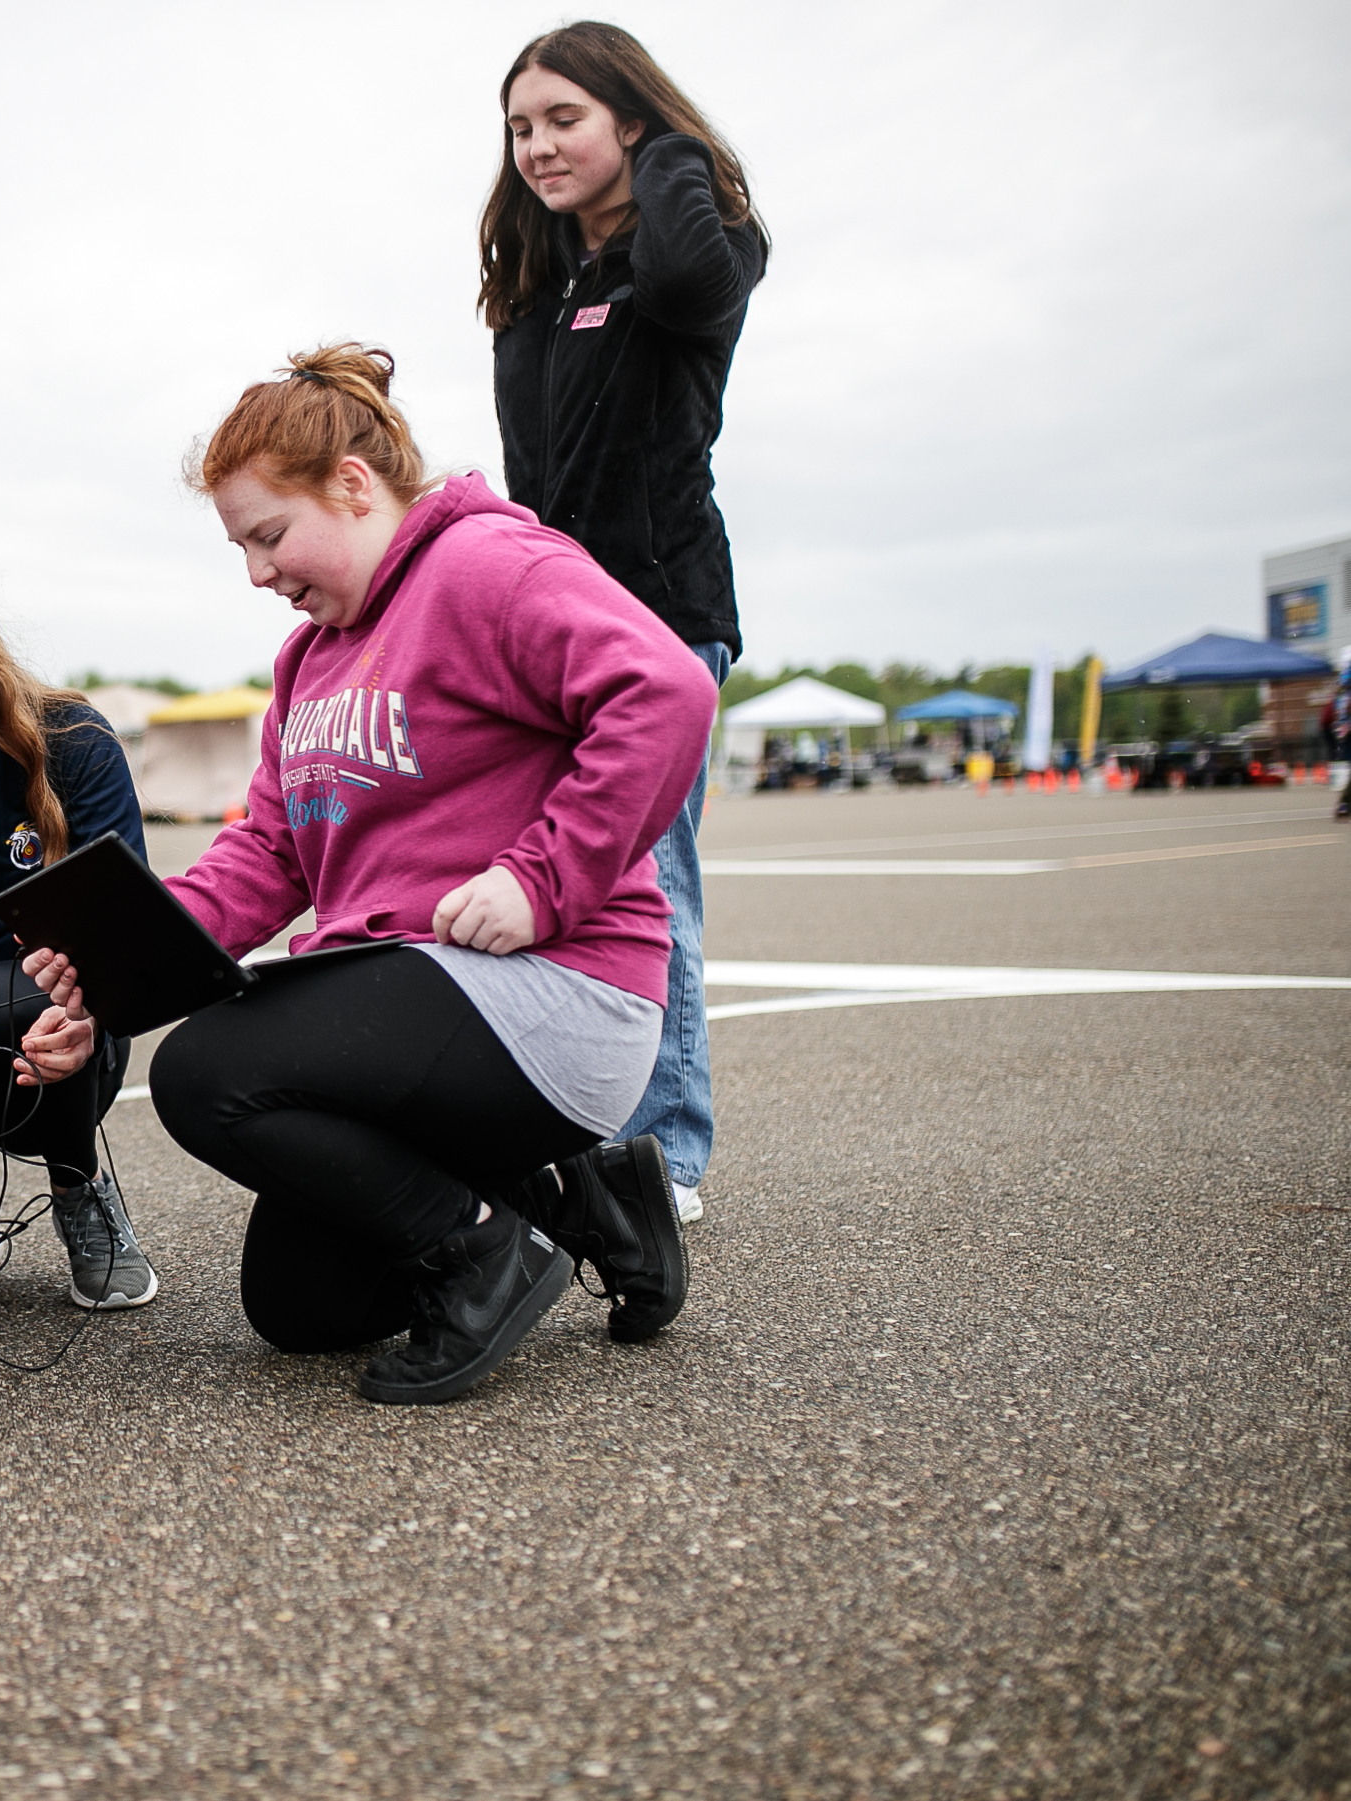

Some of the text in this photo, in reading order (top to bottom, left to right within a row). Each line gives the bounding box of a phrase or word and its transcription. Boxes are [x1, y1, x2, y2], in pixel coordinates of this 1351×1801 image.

[281, 764, 338, 791] UNSHINE STATE
[284, 784, 350, 831] lorida
